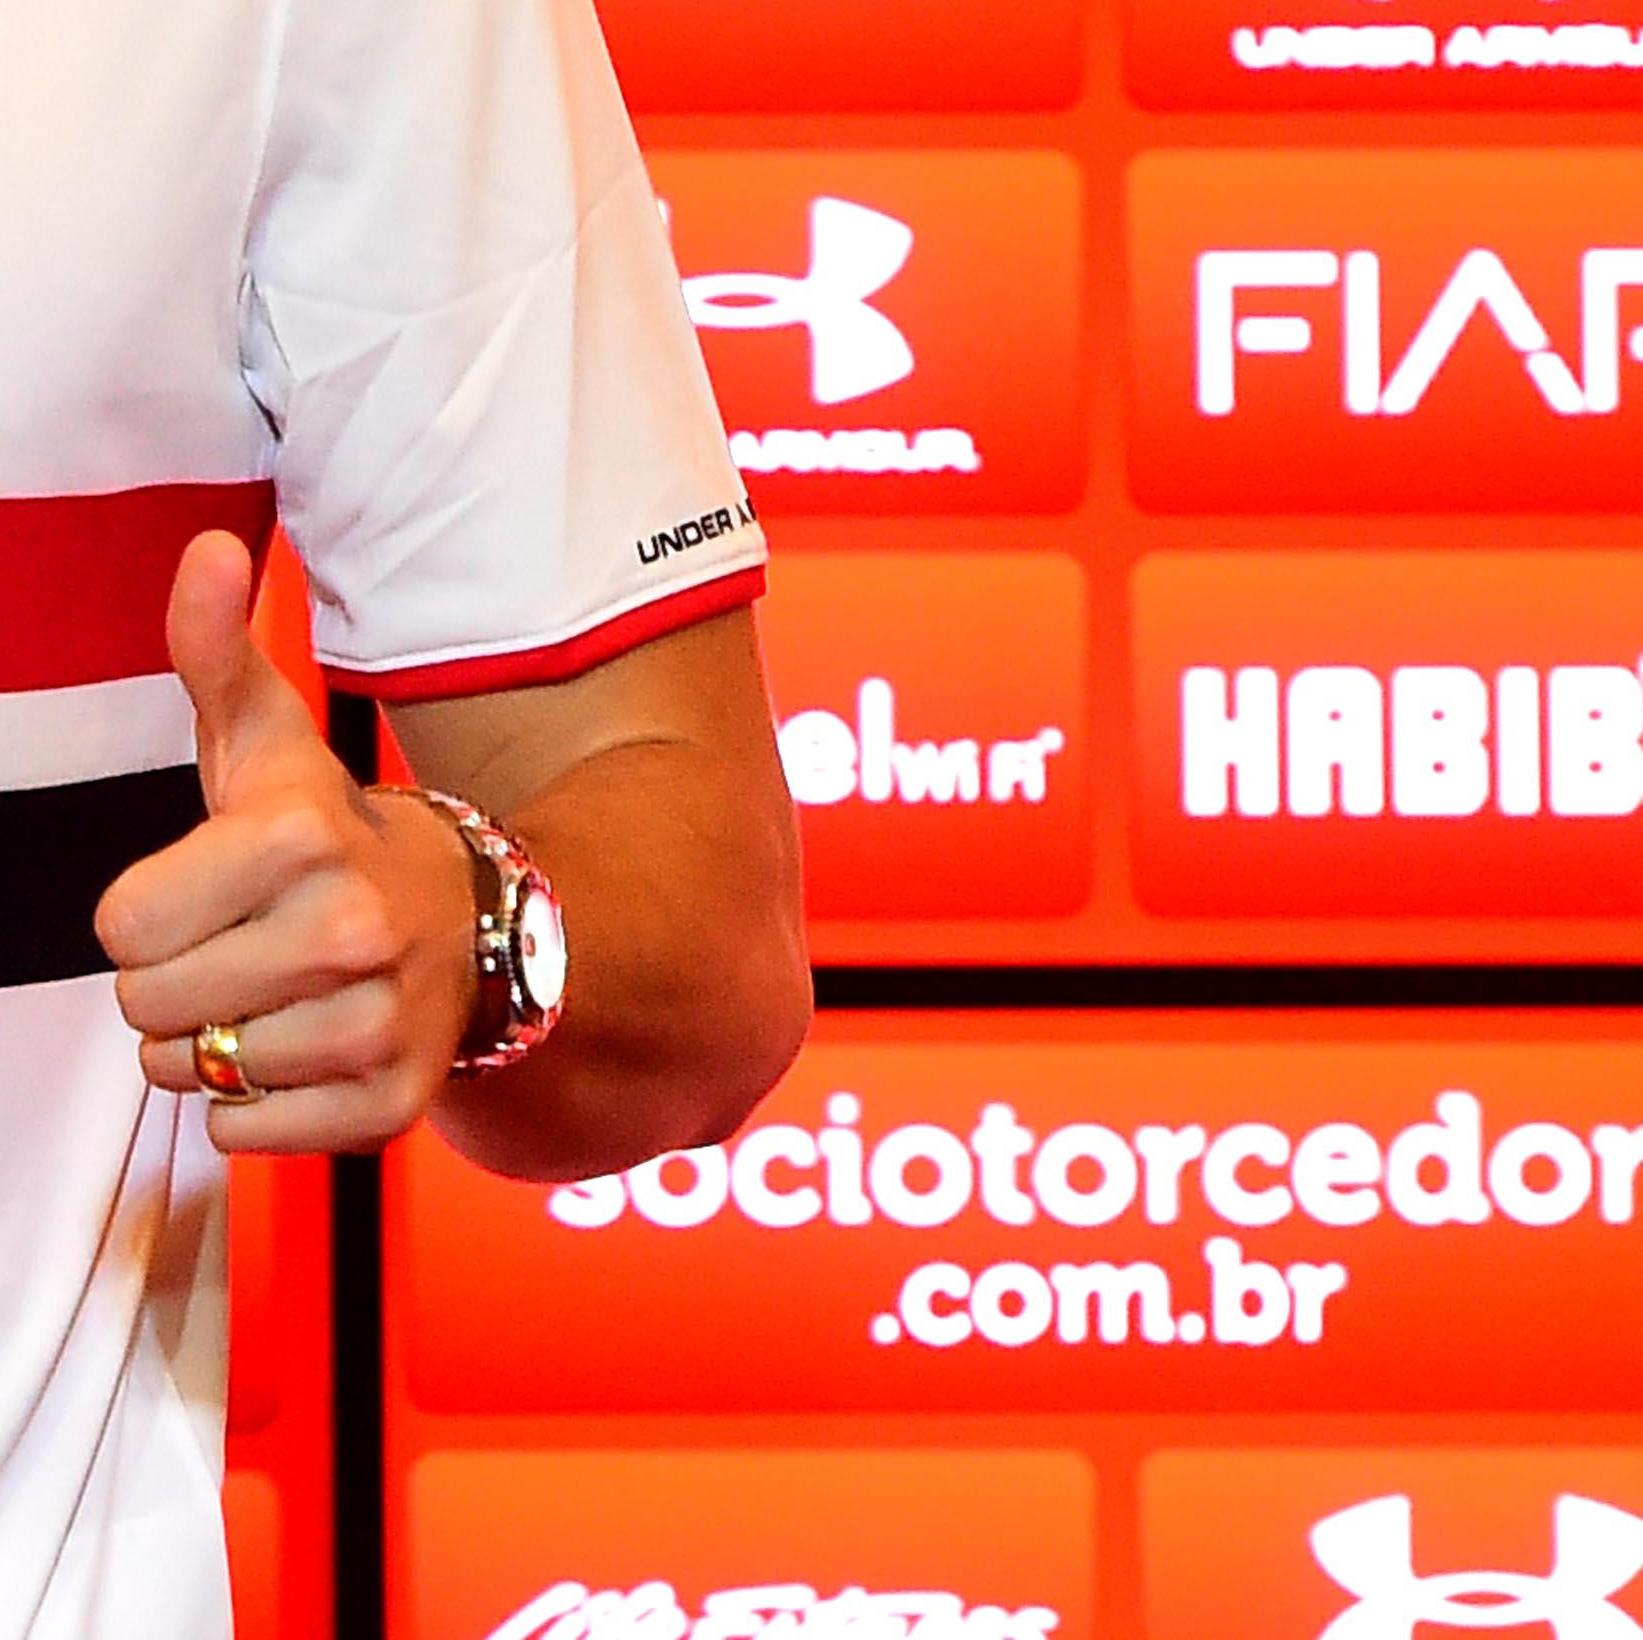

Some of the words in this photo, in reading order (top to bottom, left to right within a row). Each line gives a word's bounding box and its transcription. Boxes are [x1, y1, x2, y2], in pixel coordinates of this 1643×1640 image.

[1232, 25, 1436, 68] UNDER
[1444, 24, 1643, 68] ARMOU
[635, 506, 734, 565] UNDER
[1181, 663, 1643, 817] HABIB
[872, 1236, 1347, 1346] .com.br
